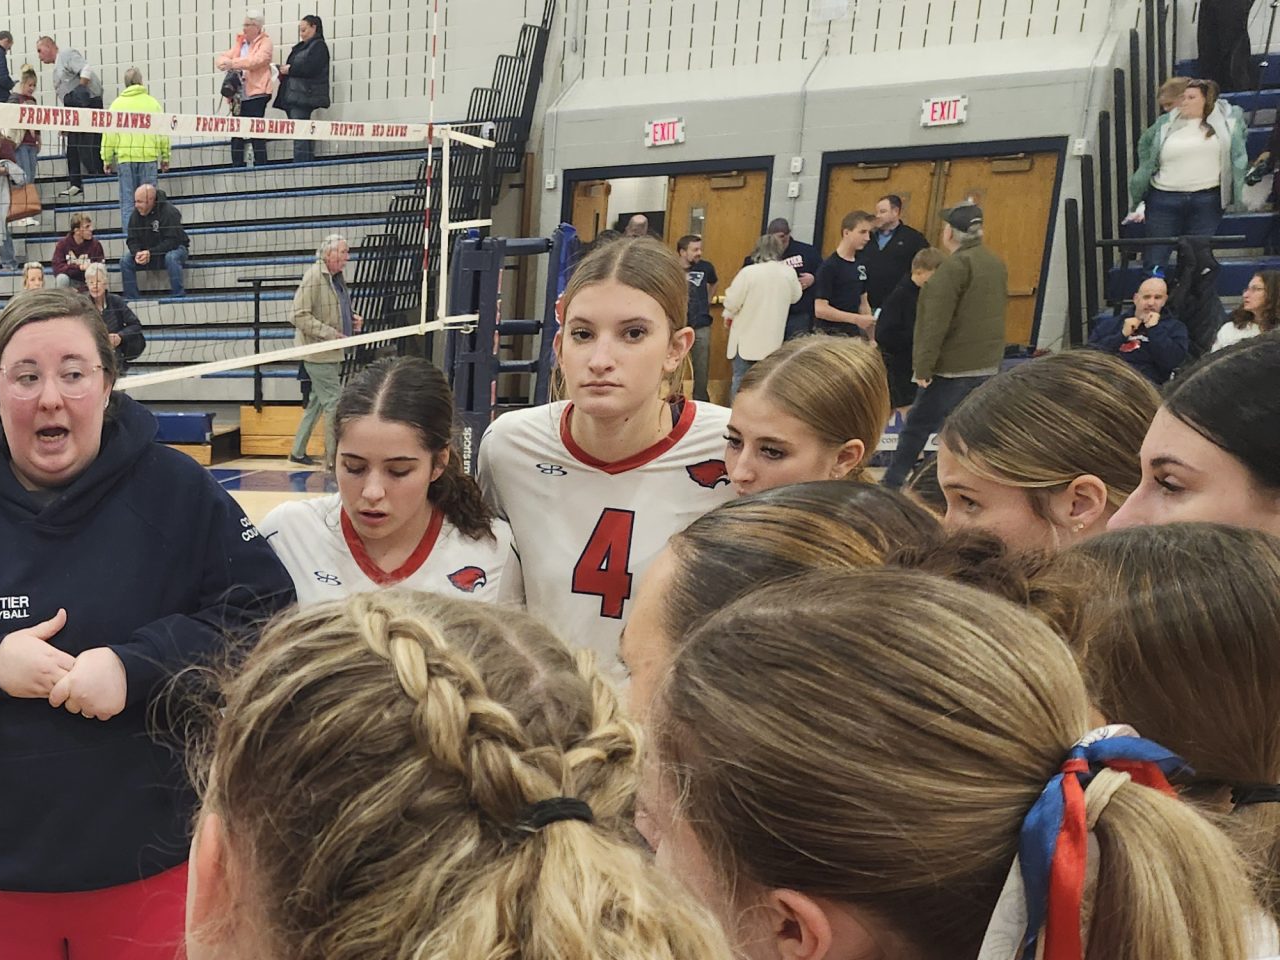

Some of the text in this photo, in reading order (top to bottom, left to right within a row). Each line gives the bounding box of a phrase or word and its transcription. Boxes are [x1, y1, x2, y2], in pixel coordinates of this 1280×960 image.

[19, 106, 152, 129] FRONTIER RED HAWKS
[930, 99, 961, 122] EXIT
[195, 116, 295, 134] FRONTIER RED HAWKS
[652, 121, 678, 143] EXIT
[462, 426, 473, 460] sports
[571, 507, 635, 619] 4
